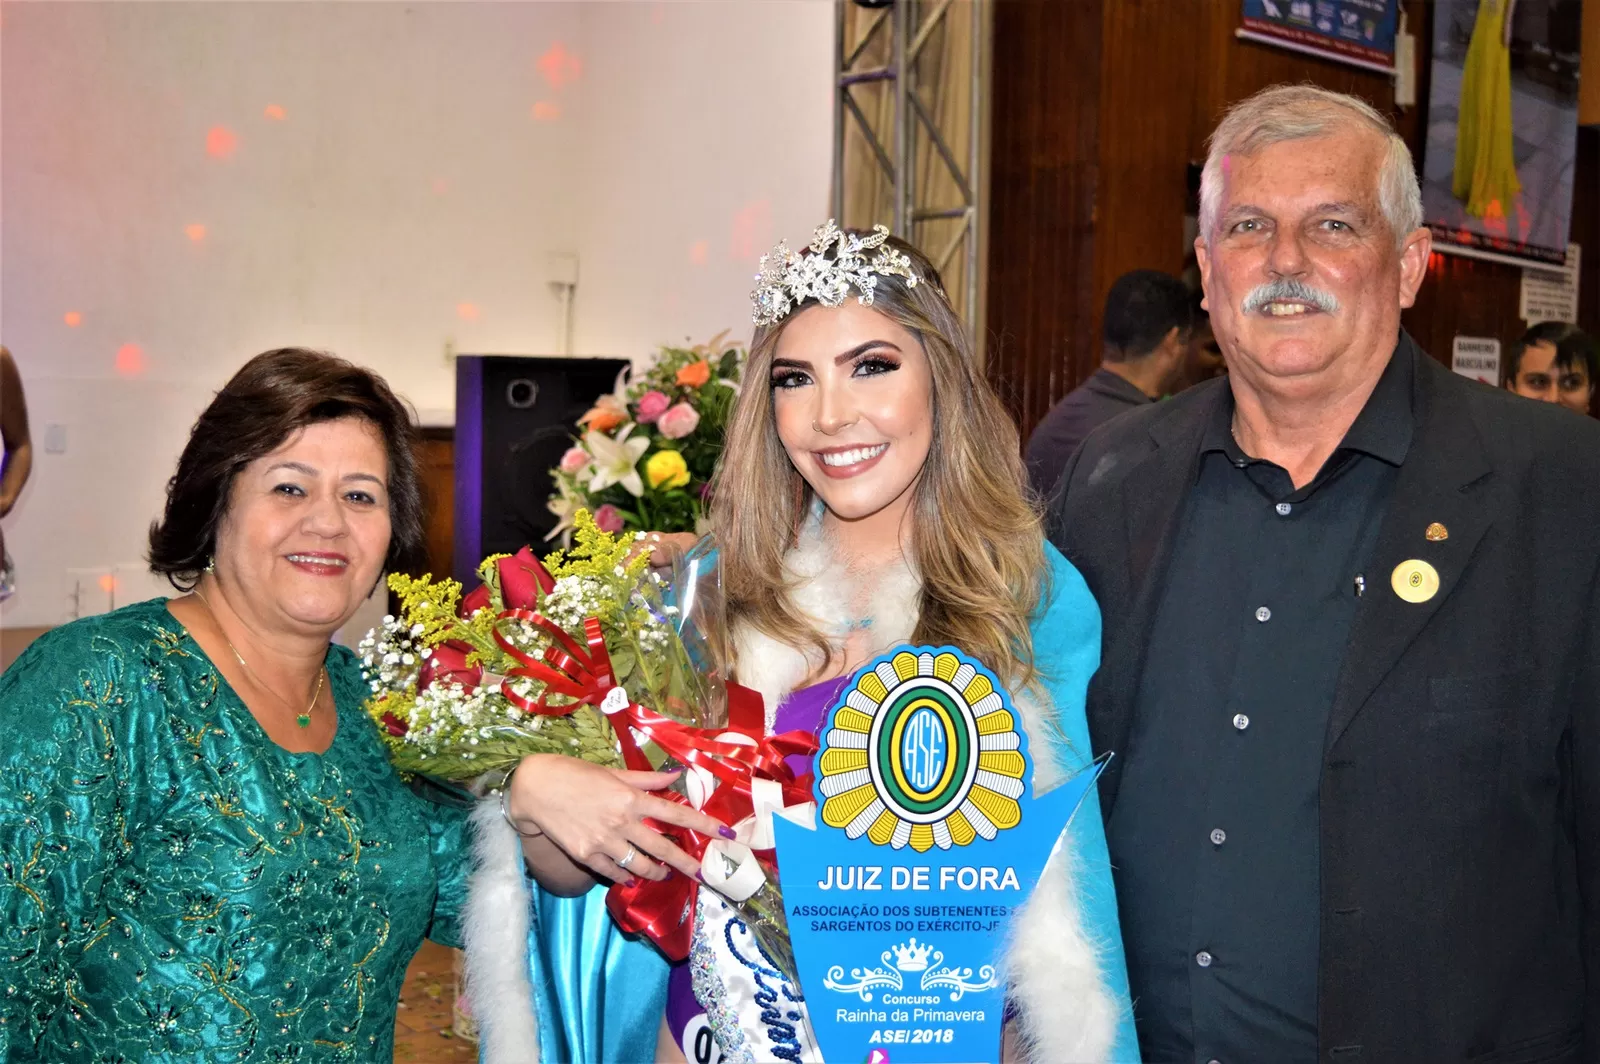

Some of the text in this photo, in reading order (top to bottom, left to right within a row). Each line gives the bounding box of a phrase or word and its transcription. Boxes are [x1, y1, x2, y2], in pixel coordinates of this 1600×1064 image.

[904, 710, 943, 789] ASE
[817, 866, 1021, 891] JUIZ DE FORA
[792, 903, 880, 919] ASSOCIAÇÃO
[882, 905, 910, 917] DOS
[914, 905, 1007, 917] SUBTENENTES
[810, 920, 892, 932] SARGENTOS
[895, 920, 914, 932] DO
[882, 993, 941, 1005] Concurso
[836, 1007, 985, 1023] Rainha da Primavera
